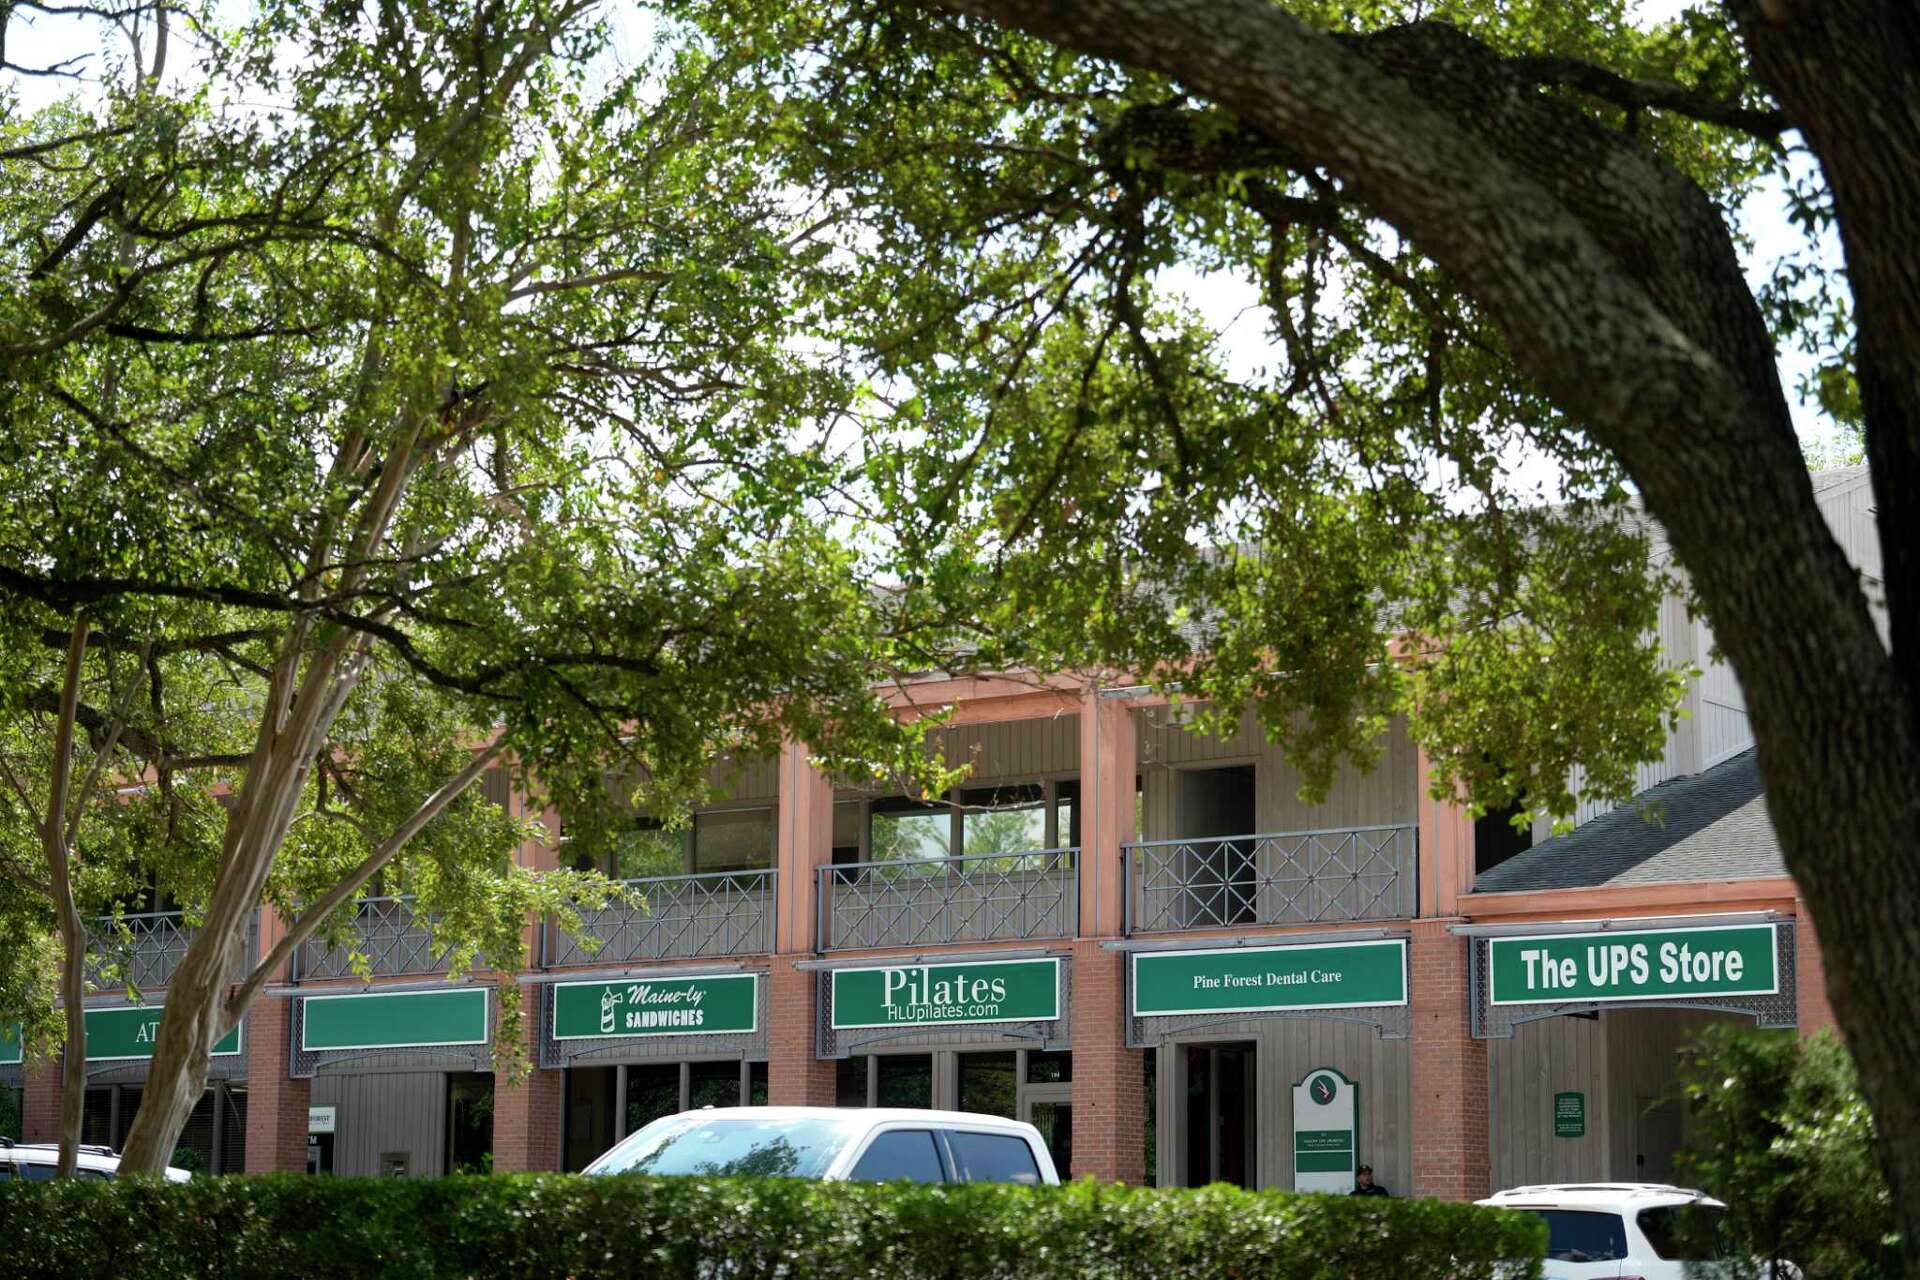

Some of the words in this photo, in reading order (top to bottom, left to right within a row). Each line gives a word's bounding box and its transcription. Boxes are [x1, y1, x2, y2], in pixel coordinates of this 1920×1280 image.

[1520, 948, 1578, 990] The
[1586, 943, 1650, 987] UPS
[1659, 941, 1744, 985] Store
[880, 967, 1007, 1008] Pilates
[1193, 975, 1221, 989] Pine
[1223, 973, 1262, 988] Forest
[1266, 971, 1308, 986] Dental
[1310, 969, 1343, 983] Care
[627, 984, 706, 1007] Maine-ly
[625, 1009, 704, 1029] SANDWICHES
[887, 1002, 1000, 1023] HLUpilates.com
[135, 1021, 160, 1043] AT
